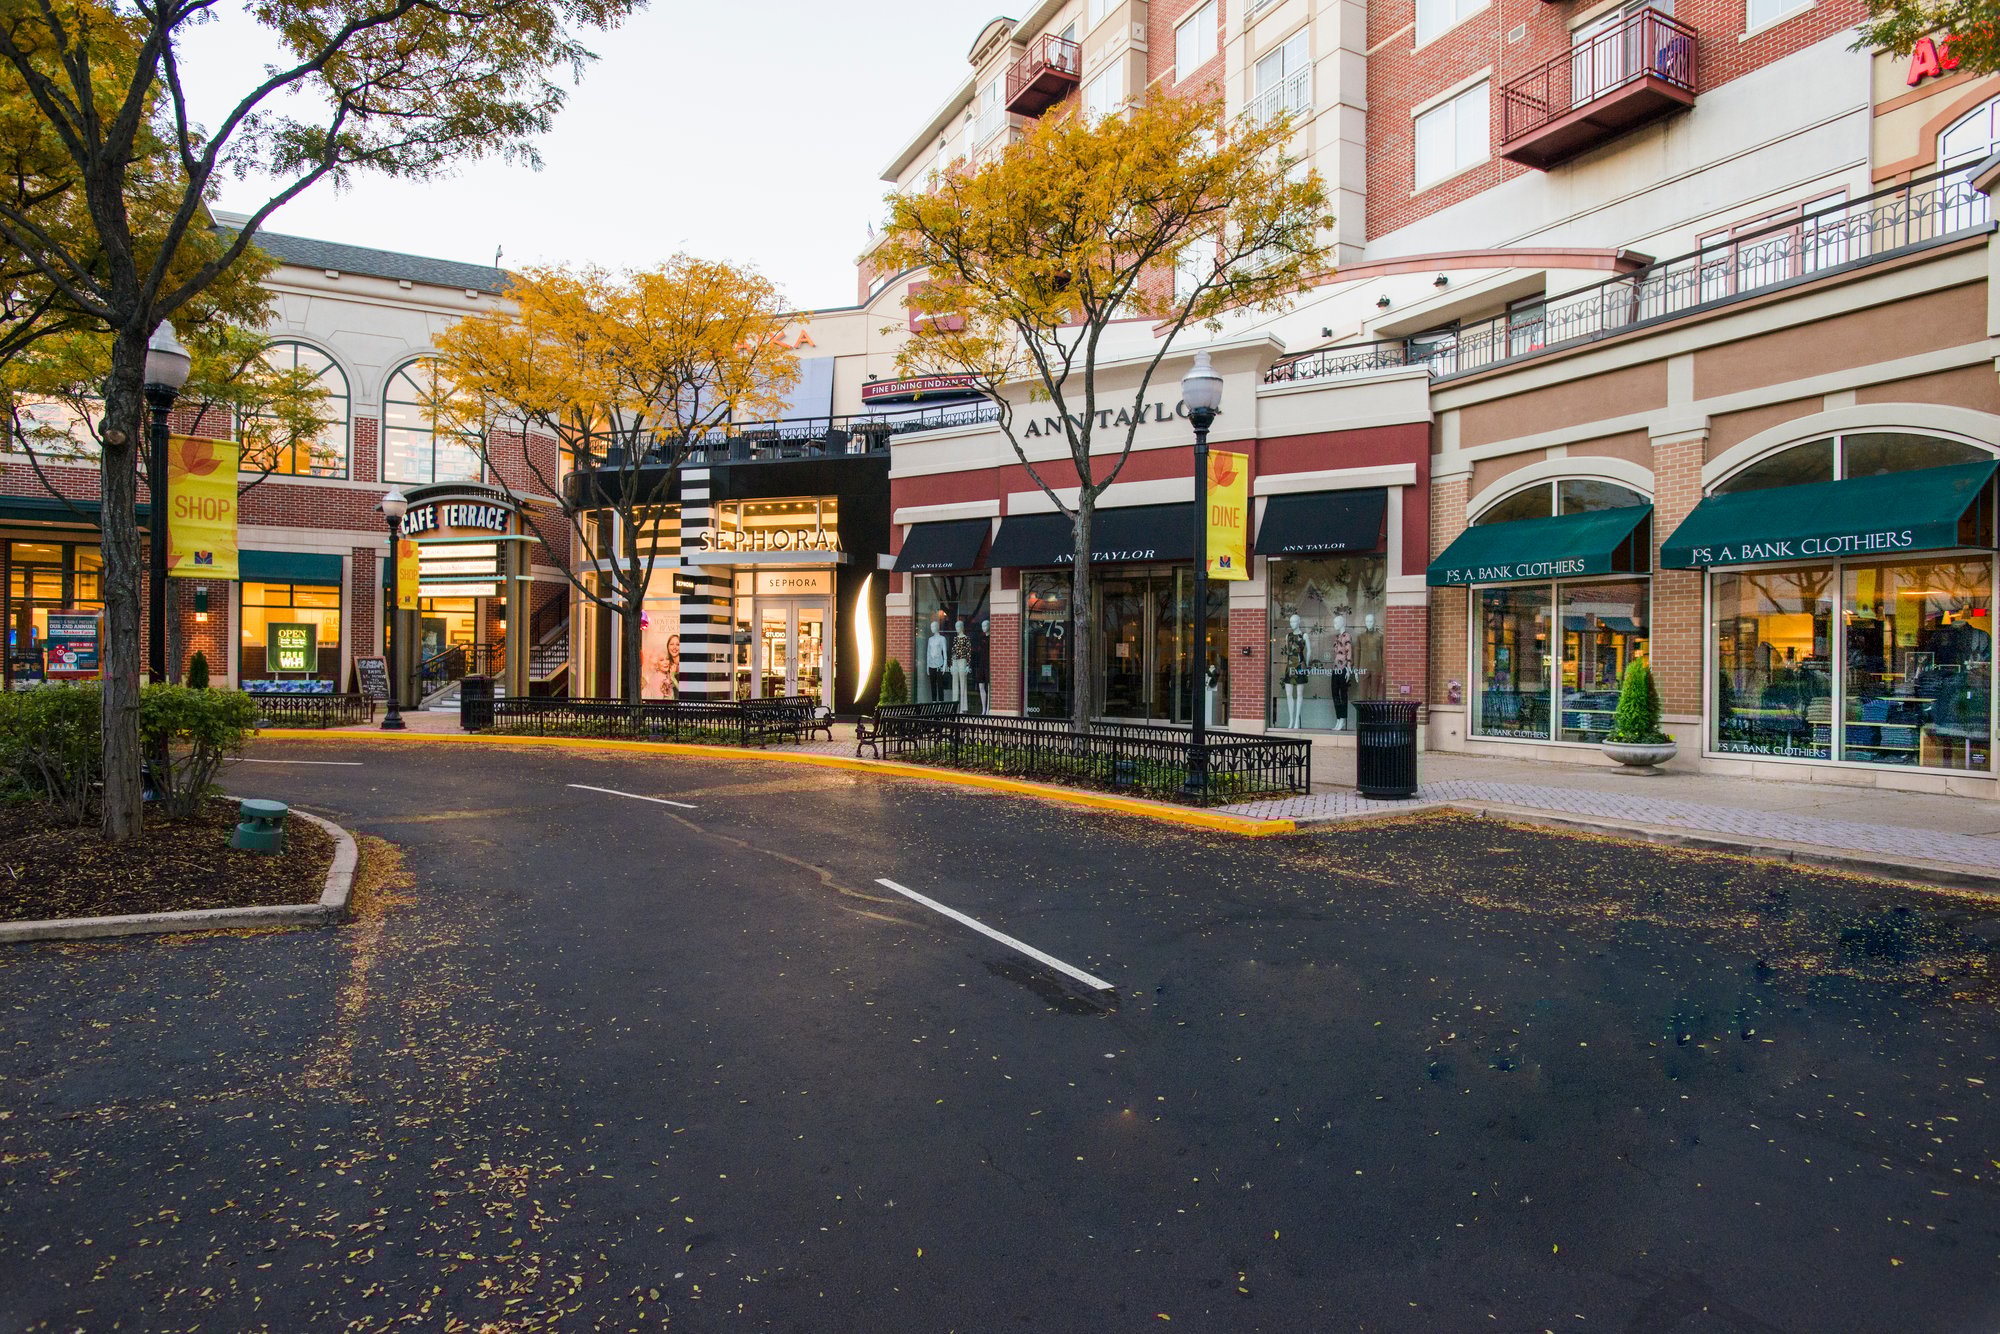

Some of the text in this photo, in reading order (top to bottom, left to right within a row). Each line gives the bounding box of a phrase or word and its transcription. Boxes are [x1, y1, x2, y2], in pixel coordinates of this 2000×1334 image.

[872, 385, 889, 394] FINE
[891, 381, 922, 391] DINING
[924, 379, 958, 389] INDIAN
[1024, 399, 1222, 438] ANN TAYLO
[174, 495, 230, 521] SHOP
[400, 505, 506, 535] CAFÉ TERRACE
[1211, 504, 1240, 529] DINE
[700, 528, 829, 550] SEPHORA
[1719, 546, 1736, 561] A.
[1741, 541, 1795, 559] BANK
[1800, 530, 1913, 554] CLOTHIERS
[1054, 549, 1155, 563] AN TAYLOR
[400, 568, 418, 580] SHOP
[1464, 569, 1476, 581] A.
[1479, 565, 1513, 580] BANK
[1516, 559, 1585, 577] CLOTHIERS
[675, 580, 694, 588] SEPHORA
[769, 579, 817, 587] SEPHORA
[278, 629, 306, 637] OPEN
[280, 651, 304, 659] FREE
[1289, 667, 1333, 676] Everything
[1345, 667, 1367, 675] Wear
[1494, 728, 1512, 737] BANK
[1513, 729, 1549, 739] CLOTHIERS
[1743, 744, 1770, 755] BANK
[1772, 746, 1827, 758] CLOTHIERS
